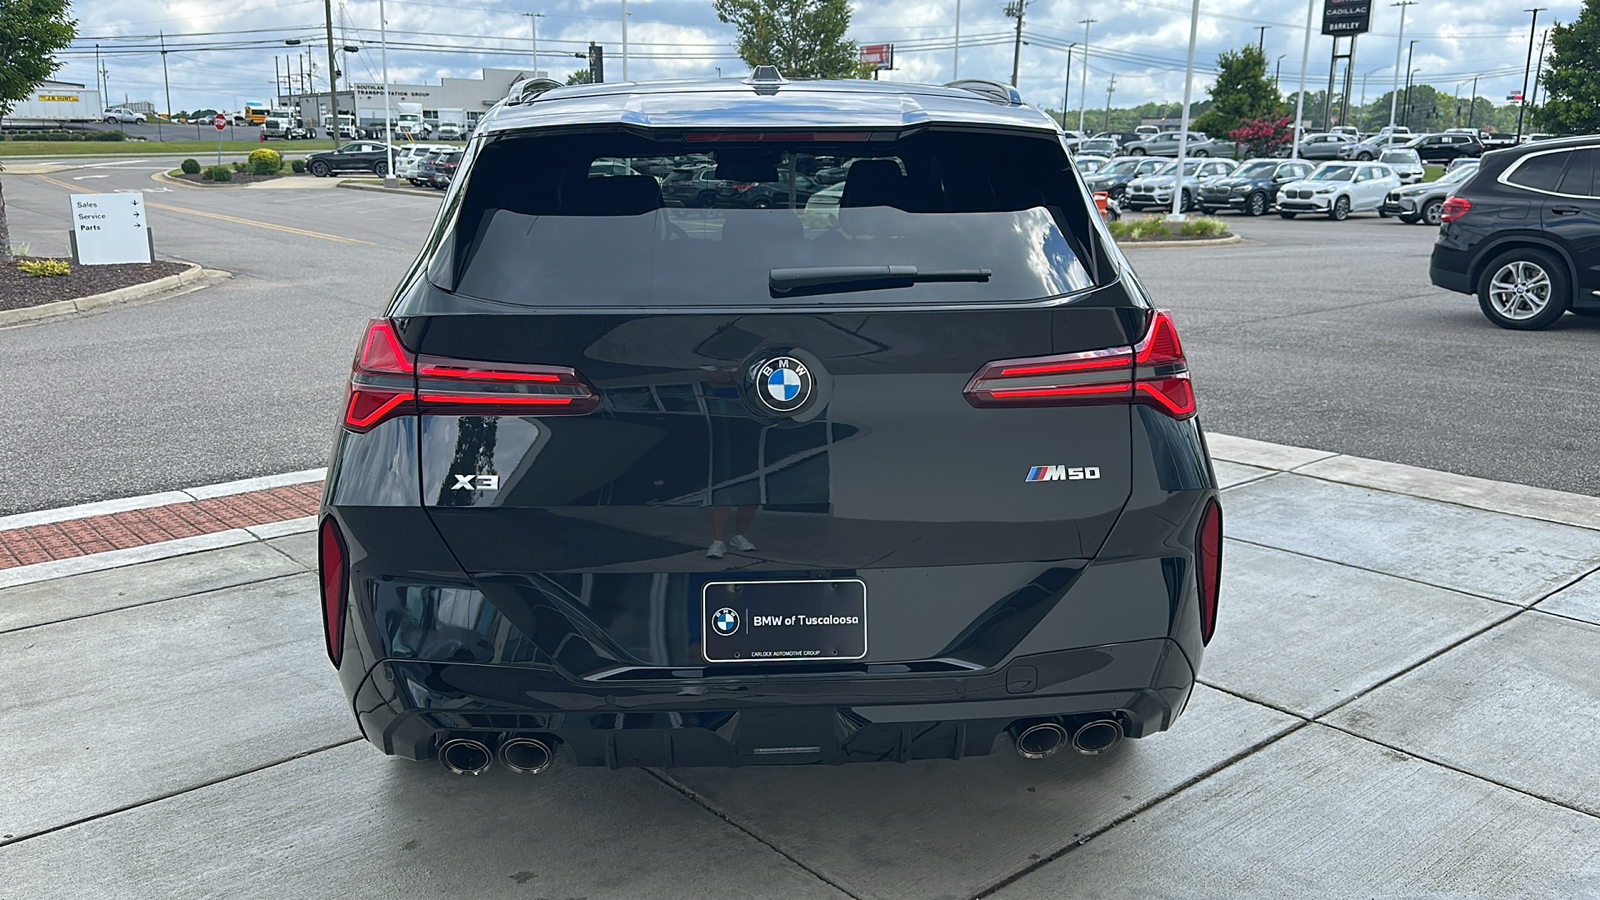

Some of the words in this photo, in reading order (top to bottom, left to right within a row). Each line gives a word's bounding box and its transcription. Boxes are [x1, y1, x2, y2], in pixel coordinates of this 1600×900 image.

[1326, 7, 1367, 16] CADILLAC
[1329, 22, 1360, 31] BARKLEY
[215, 118, 226, 126] STOP
[762, 359, 807, 377] BMW
[1040, 464, 1101, 481] M50
[451, 474, 499, 491] X3
[716, 609, 736, 618] BMW
[753, 616, 783, 627] BMW
[784, 615, 796, 626] of
[797, 614, 859, 626] Tuscaloosa
